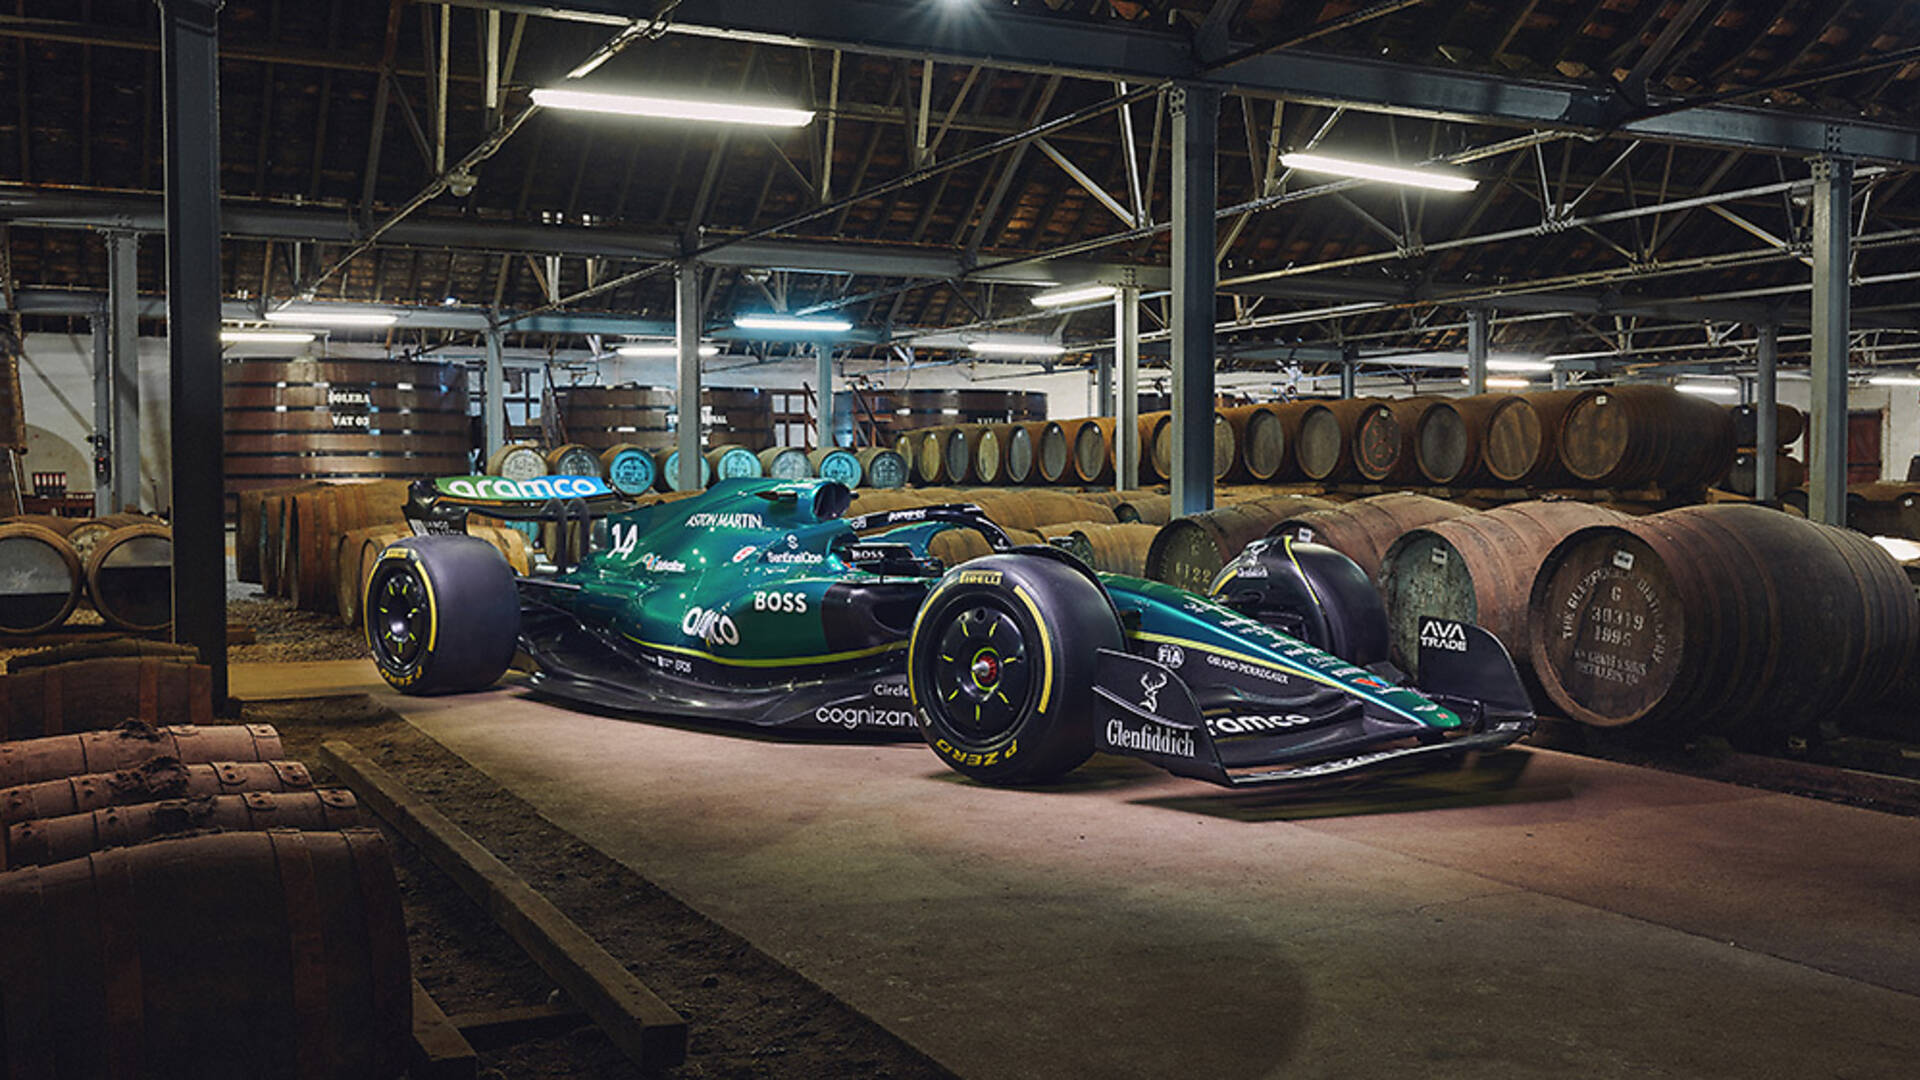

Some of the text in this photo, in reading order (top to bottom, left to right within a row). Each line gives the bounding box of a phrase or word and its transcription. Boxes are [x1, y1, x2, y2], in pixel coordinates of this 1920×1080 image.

[332, 415, 354, 426] VAT
[448, 478, 598, 498] aramco
[685, 512, 763, 529] ASTON MARTIN
[606, 523, 638, 560] 14
[767, 551, 824, 564] SentinelOne
[851, 549, 885, 560] BOSS
[754, 591, 808, 613] BOSS
[1591, 607, 1644, 631] 30319
[1422, 621, 1466, 640] AVA
[1594, 625, 1633, 647] 1995
[1421, 636, 1467, 652] TRADE
[1158, 648, 1182, 666] FIA
[1205, 713, 1311, 736] ramco
[1106, 718, 1195, 757] Glenfiddich
[935, 739, 1018, 767] P ZERO
